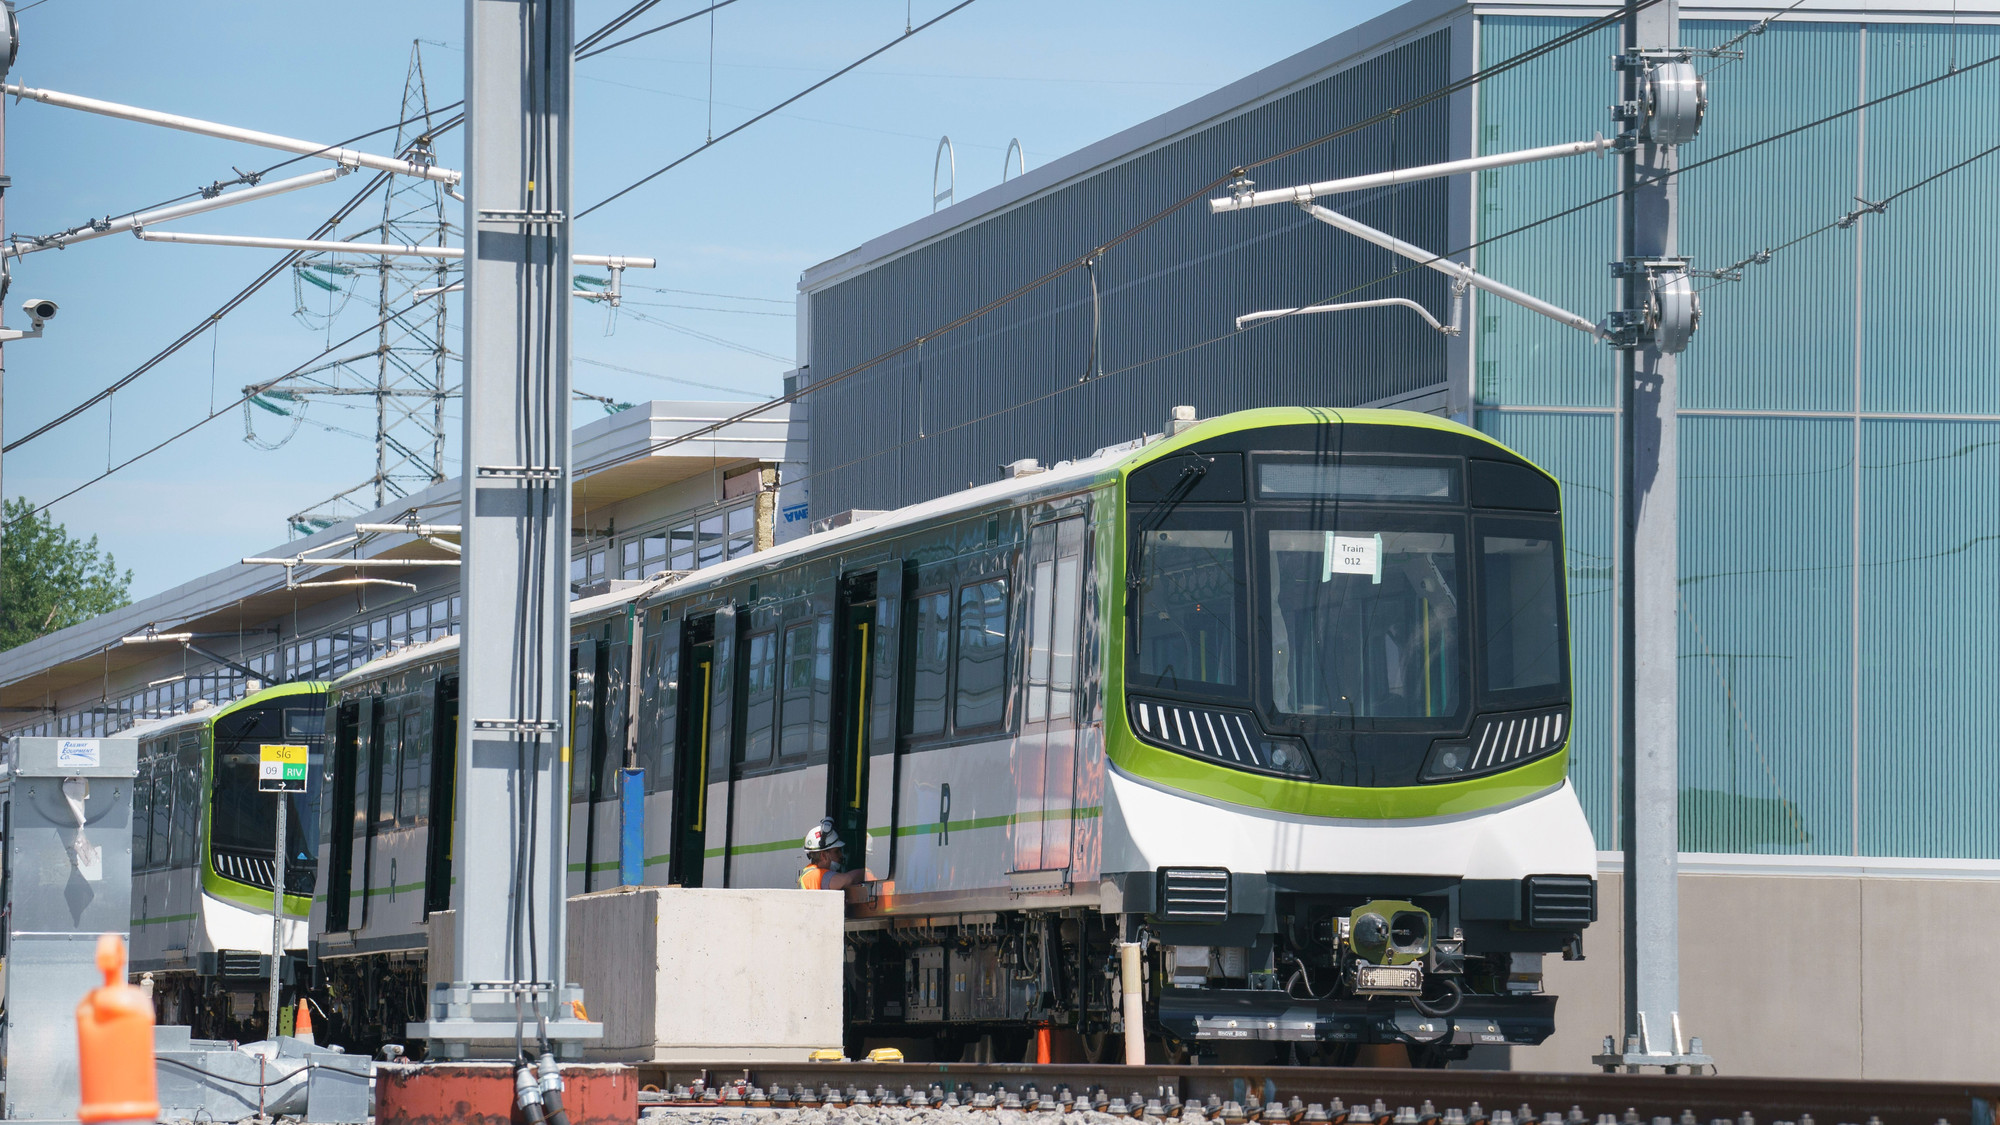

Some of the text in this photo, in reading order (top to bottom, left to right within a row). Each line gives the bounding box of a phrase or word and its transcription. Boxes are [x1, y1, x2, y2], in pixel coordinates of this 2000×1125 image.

[1342, 545, 1364, 553] Train
[276, 750, 291, 759] SIG
[266, 767, 303, 776] 09 RIV
[938, 783, 951, 846] R
